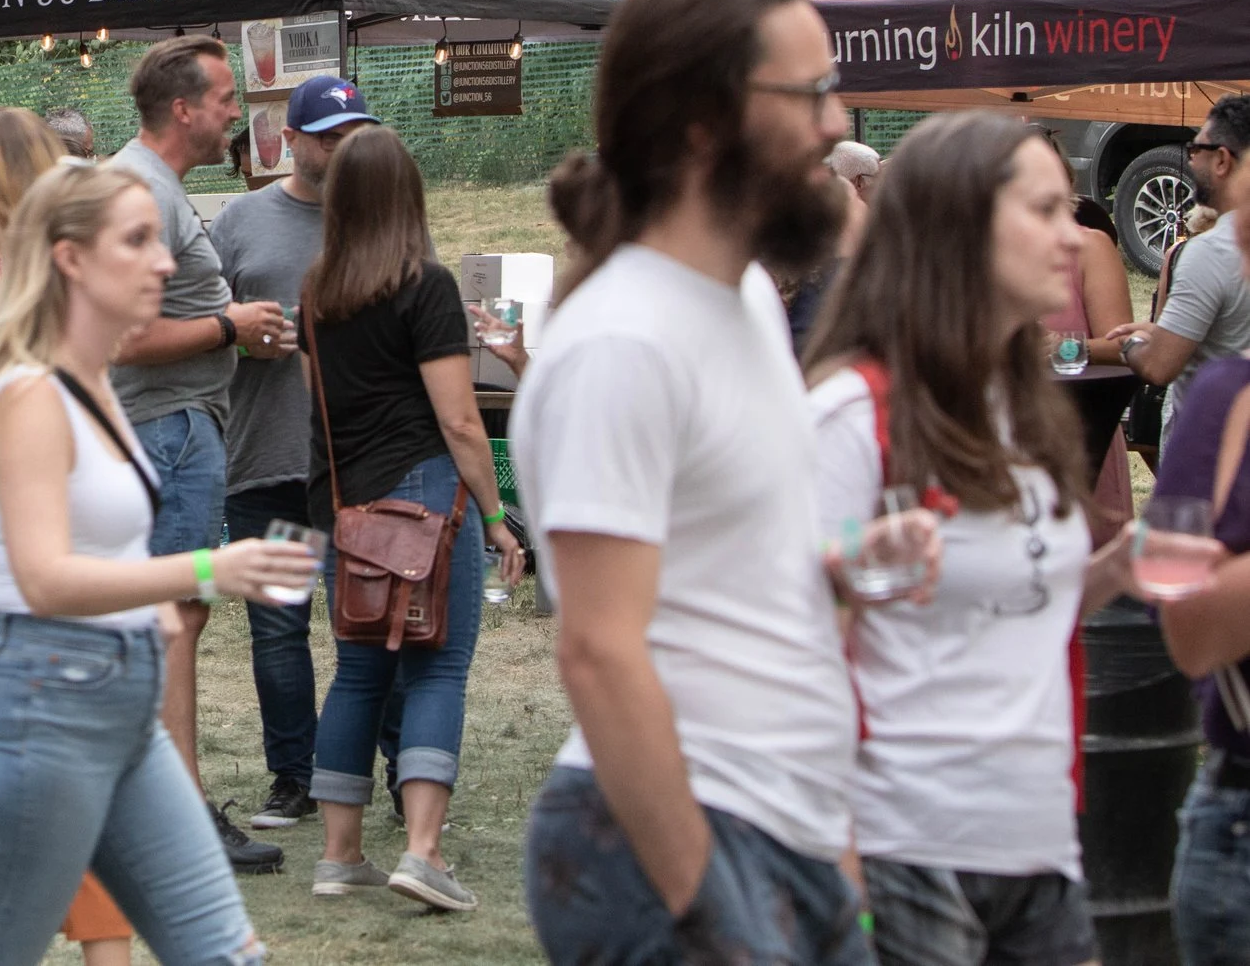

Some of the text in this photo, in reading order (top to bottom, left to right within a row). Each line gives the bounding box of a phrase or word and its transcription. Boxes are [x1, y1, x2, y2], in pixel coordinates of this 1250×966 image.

[288, 31, 319, 48] VODKA
[830, 9, 1176, 70] urning kiln winery
[472, 43, 511, 55] COMMUNIT
